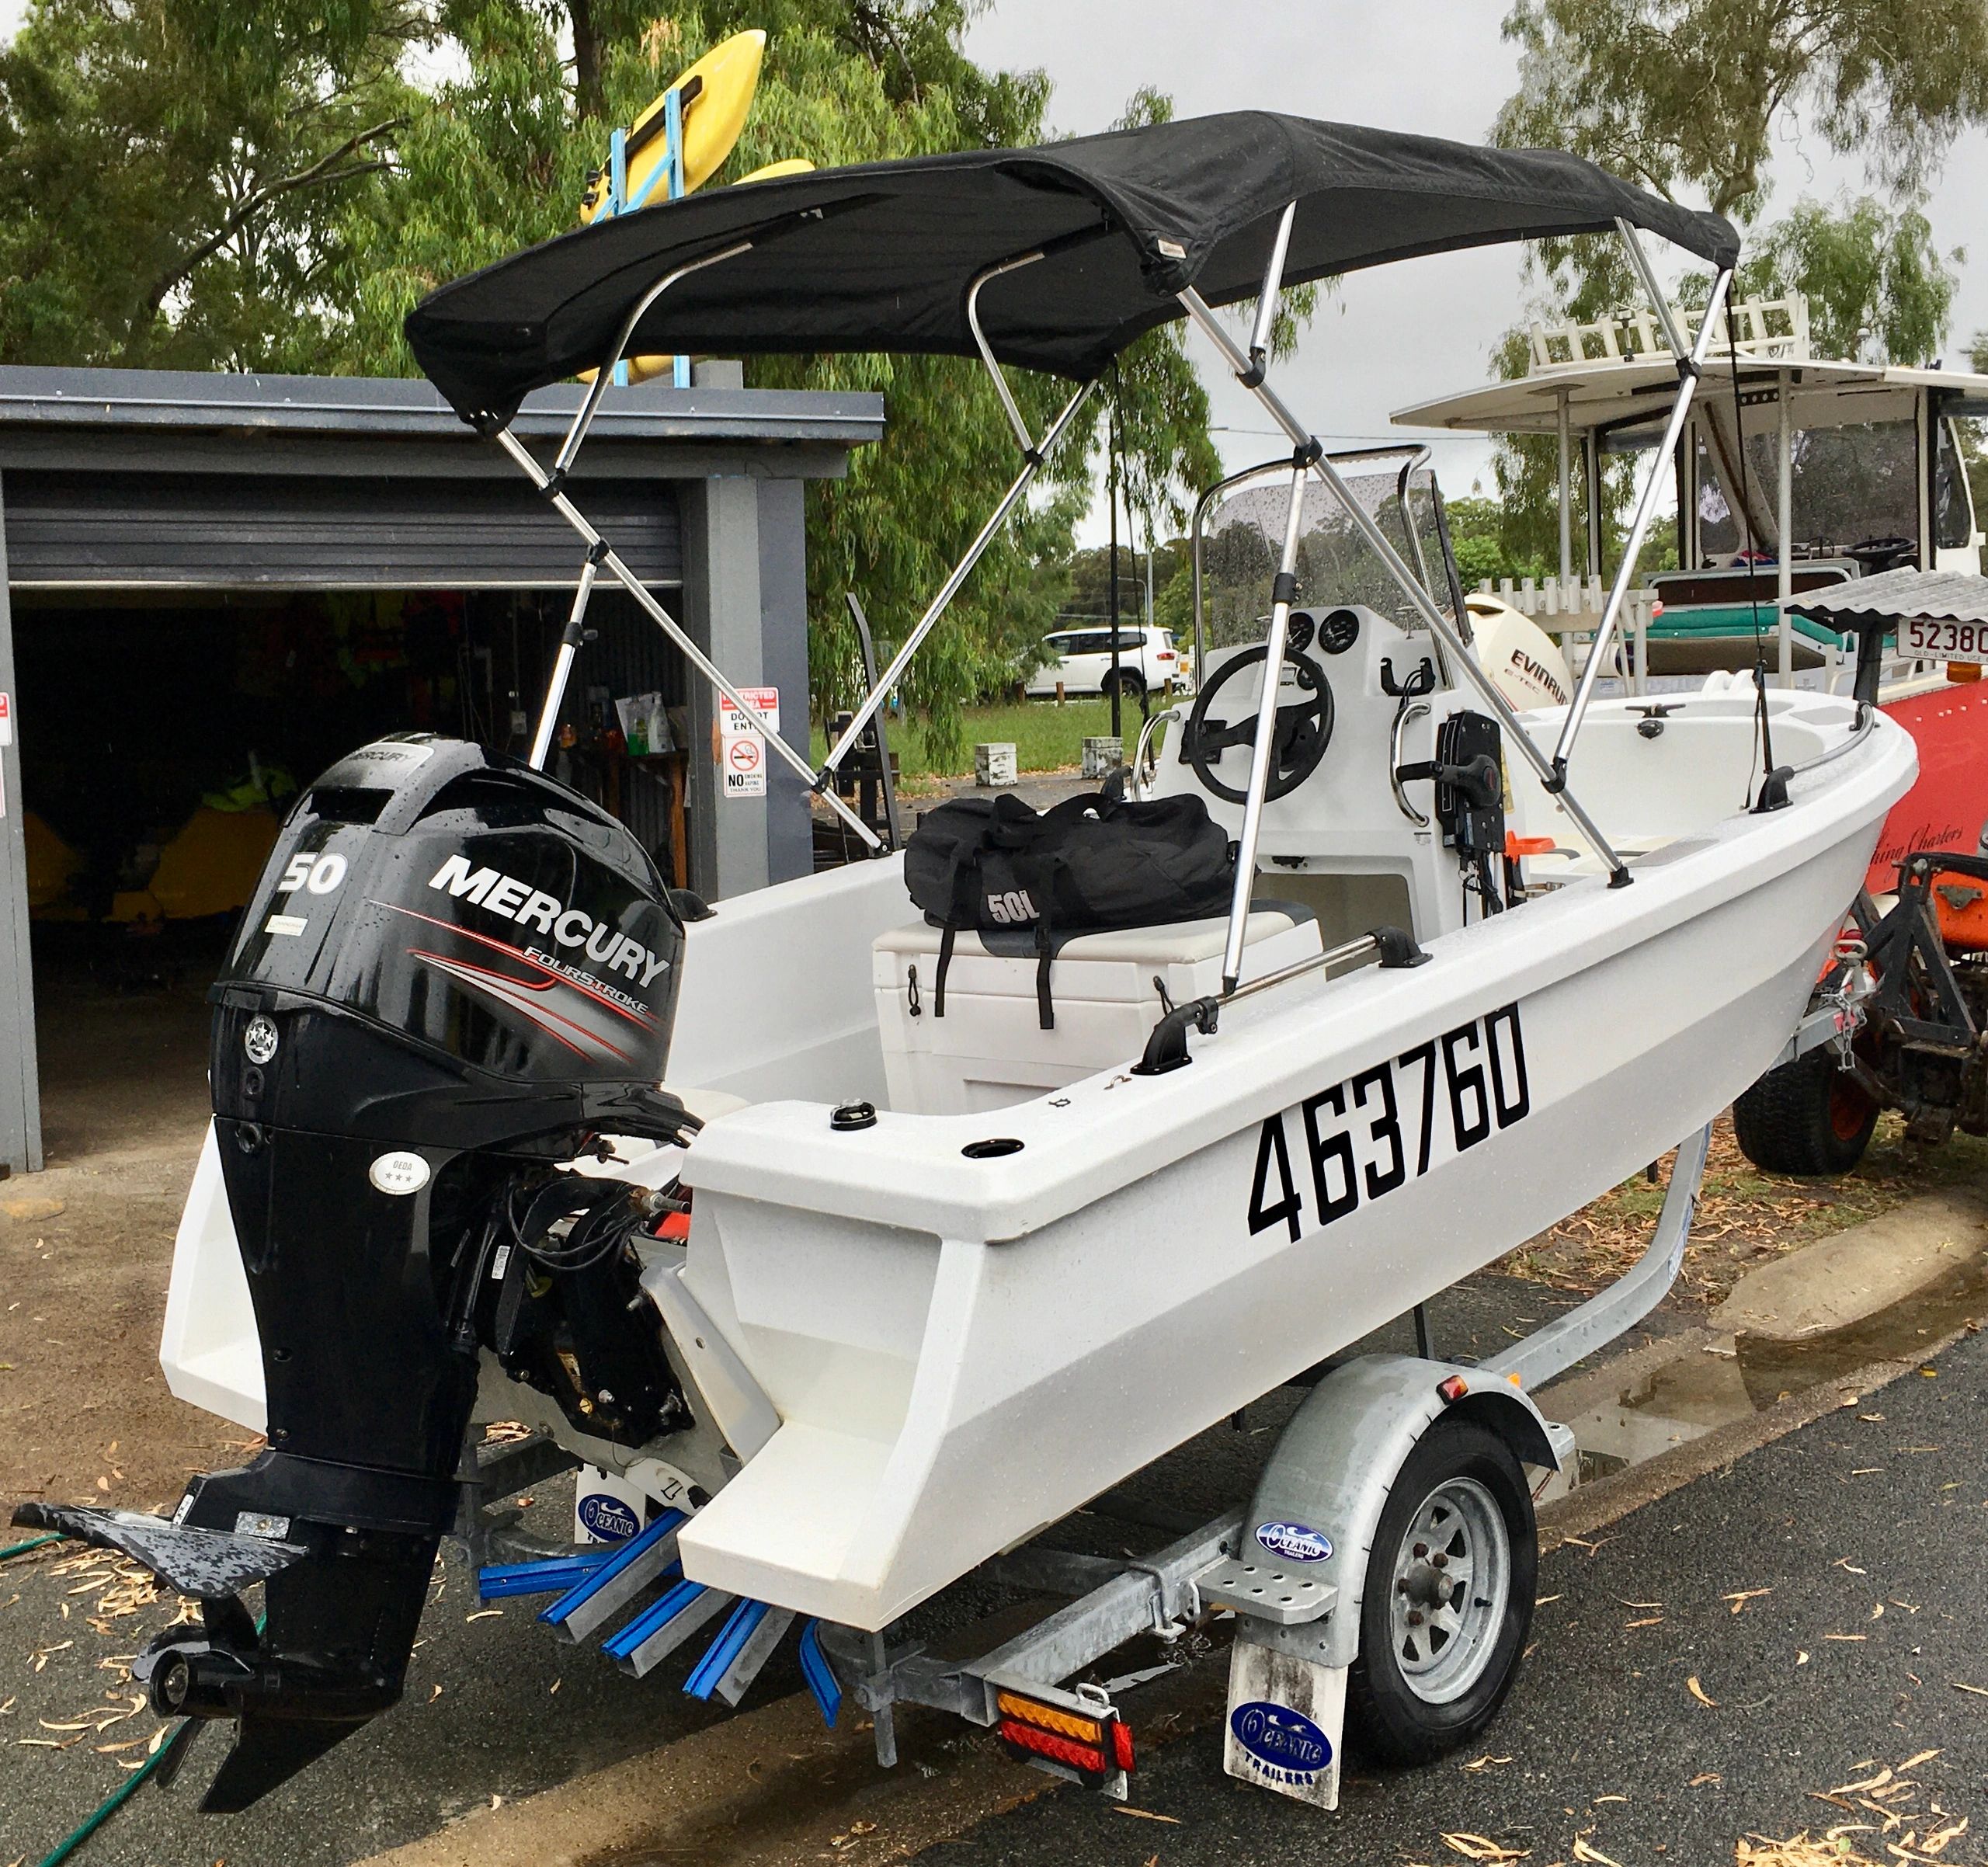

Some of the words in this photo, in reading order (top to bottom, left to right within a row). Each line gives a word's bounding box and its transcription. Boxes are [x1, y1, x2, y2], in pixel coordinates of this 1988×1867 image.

[728, 774, 744, 787] NO
[276, 851, 349, 895] 50
[428, 854, 670, 989] MERCURY
[987, 889, 1041, 923] 50L
[522, 945, 649, 1015] FOURSTROKE
[1247, 1001, 1531, 1244] 463760
[1284, 1549, 1305, 1559] TRAILERS
[1245, 1751, 1314, 1785] TRAILERS
